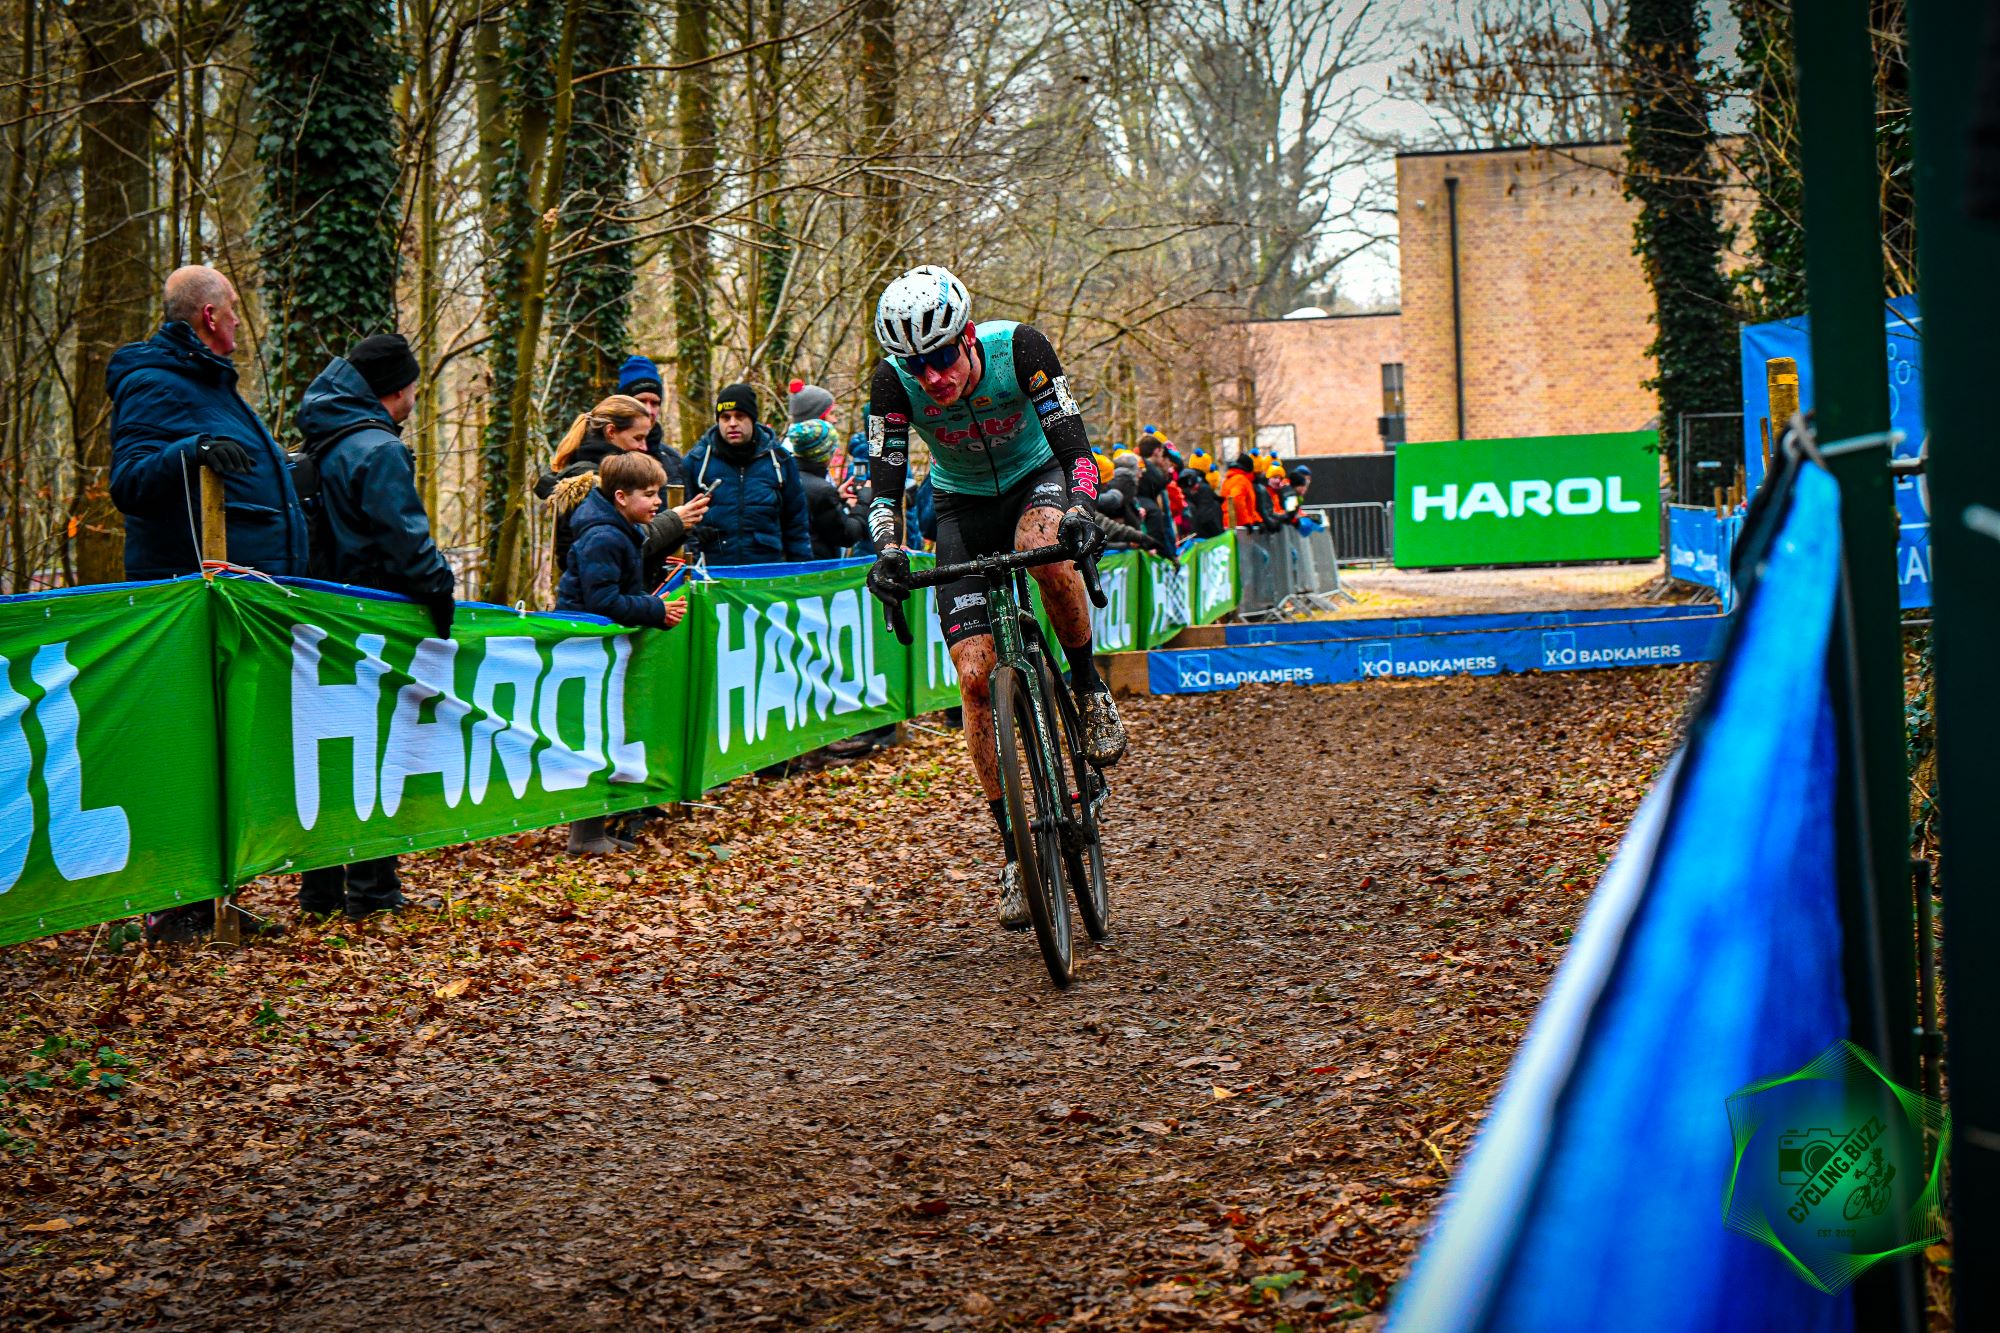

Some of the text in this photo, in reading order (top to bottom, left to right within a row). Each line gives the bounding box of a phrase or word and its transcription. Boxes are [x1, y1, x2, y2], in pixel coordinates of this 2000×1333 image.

[1412, 476, 1641, 522] HAROL
[716, 586, 887, 754] HAROL
[1396, 656, 1497, 675] BADKAMERS
[1580, 645, 1681, 663] BADKAMERS
[1214, 667, 1314, 685] BADKAMERS
[290, 623, 648, 831] HAROL
